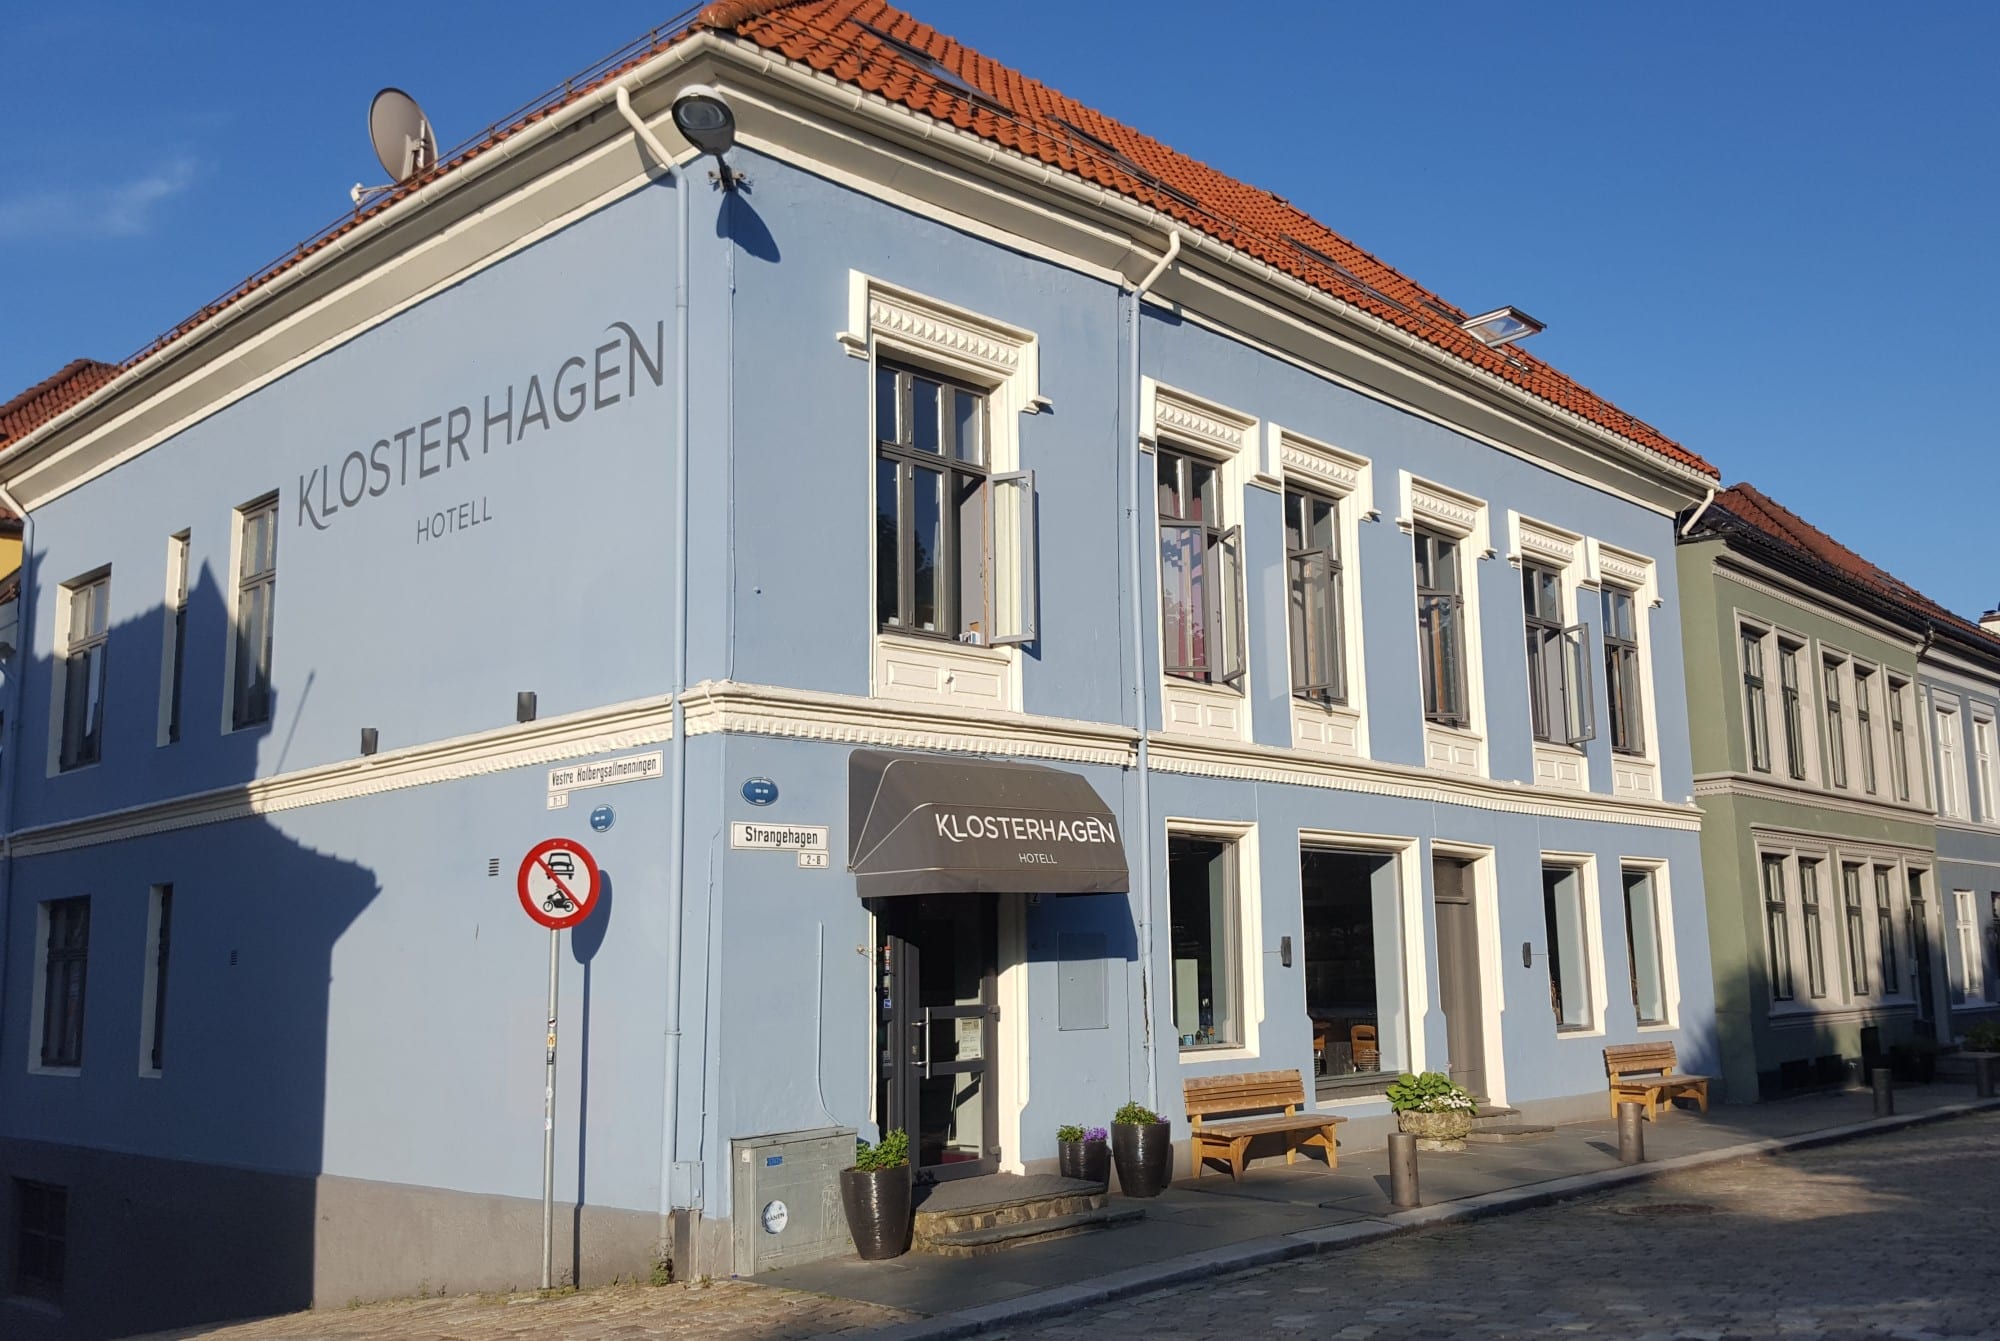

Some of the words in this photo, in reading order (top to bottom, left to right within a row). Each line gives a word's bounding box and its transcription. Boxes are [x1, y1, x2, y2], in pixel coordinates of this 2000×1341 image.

[417, 496, 492, 544] HOTELL
[552, 772, 573, 787] Vestre
[745, 826, 818, 848] Strangehagen
[935, 813, 1116, 844] KLOSTERHAGEN
[1019, 852, 1058, 865] HOTELL
